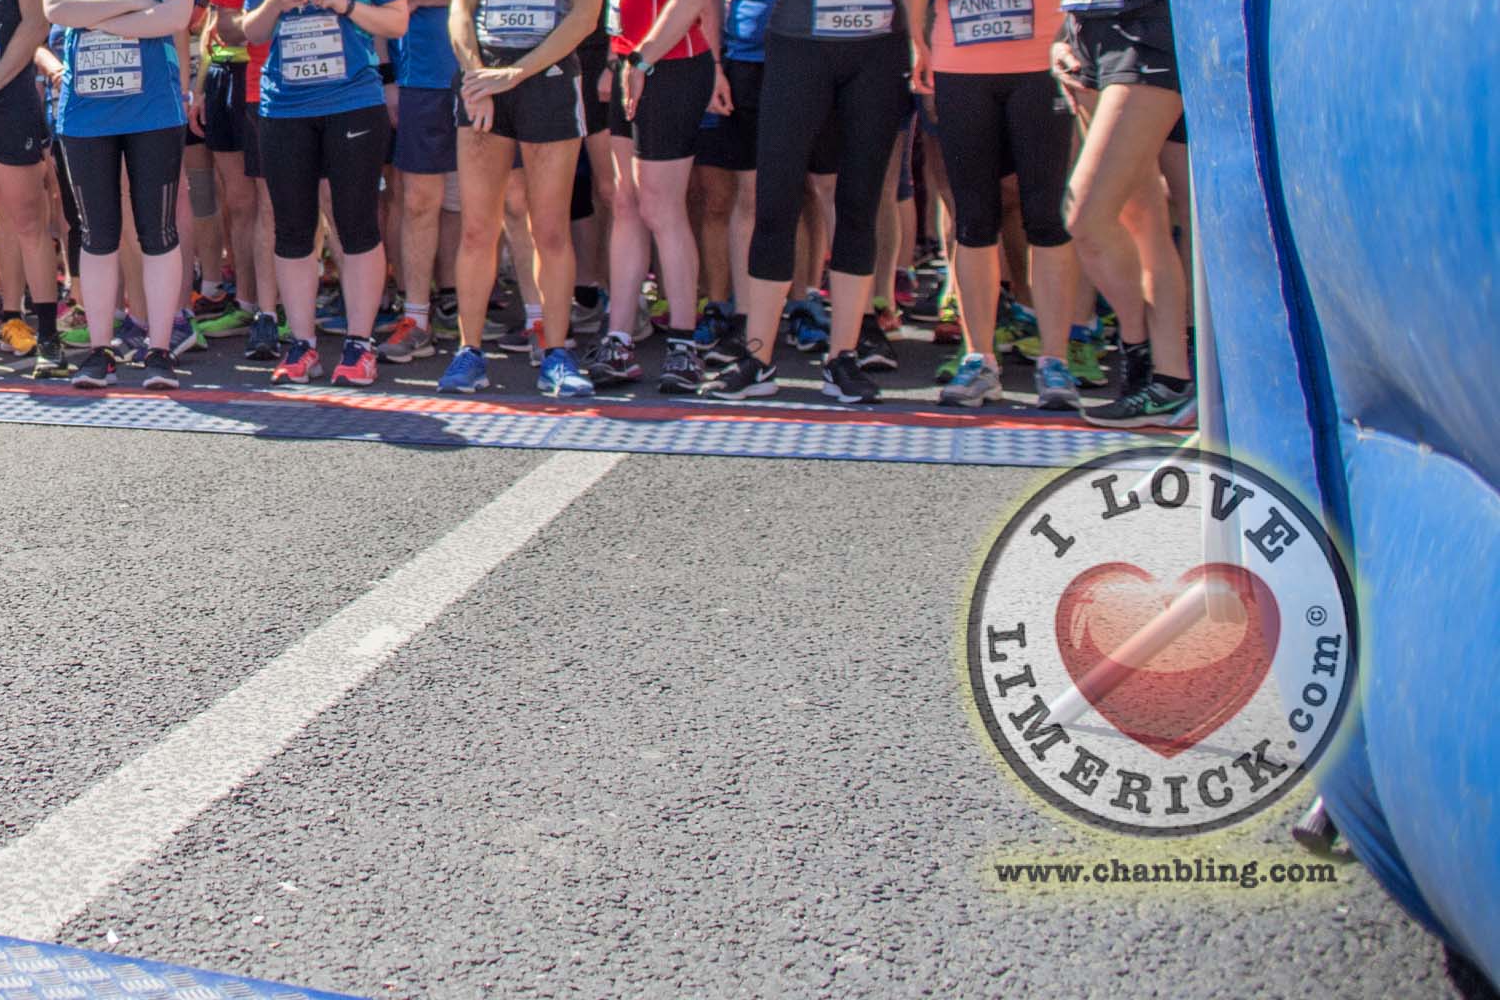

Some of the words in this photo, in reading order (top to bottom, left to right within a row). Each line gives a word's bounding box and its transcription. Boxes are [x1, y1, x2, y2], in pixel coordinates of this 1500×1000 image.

[500, 13, 536, 26] 5601
[832, 14, 874, 28] 9665
[972, 20, 1013, 37] 6902
[292, 61, 328, 78] 7614
[90, 76, 124, 91] 8794
